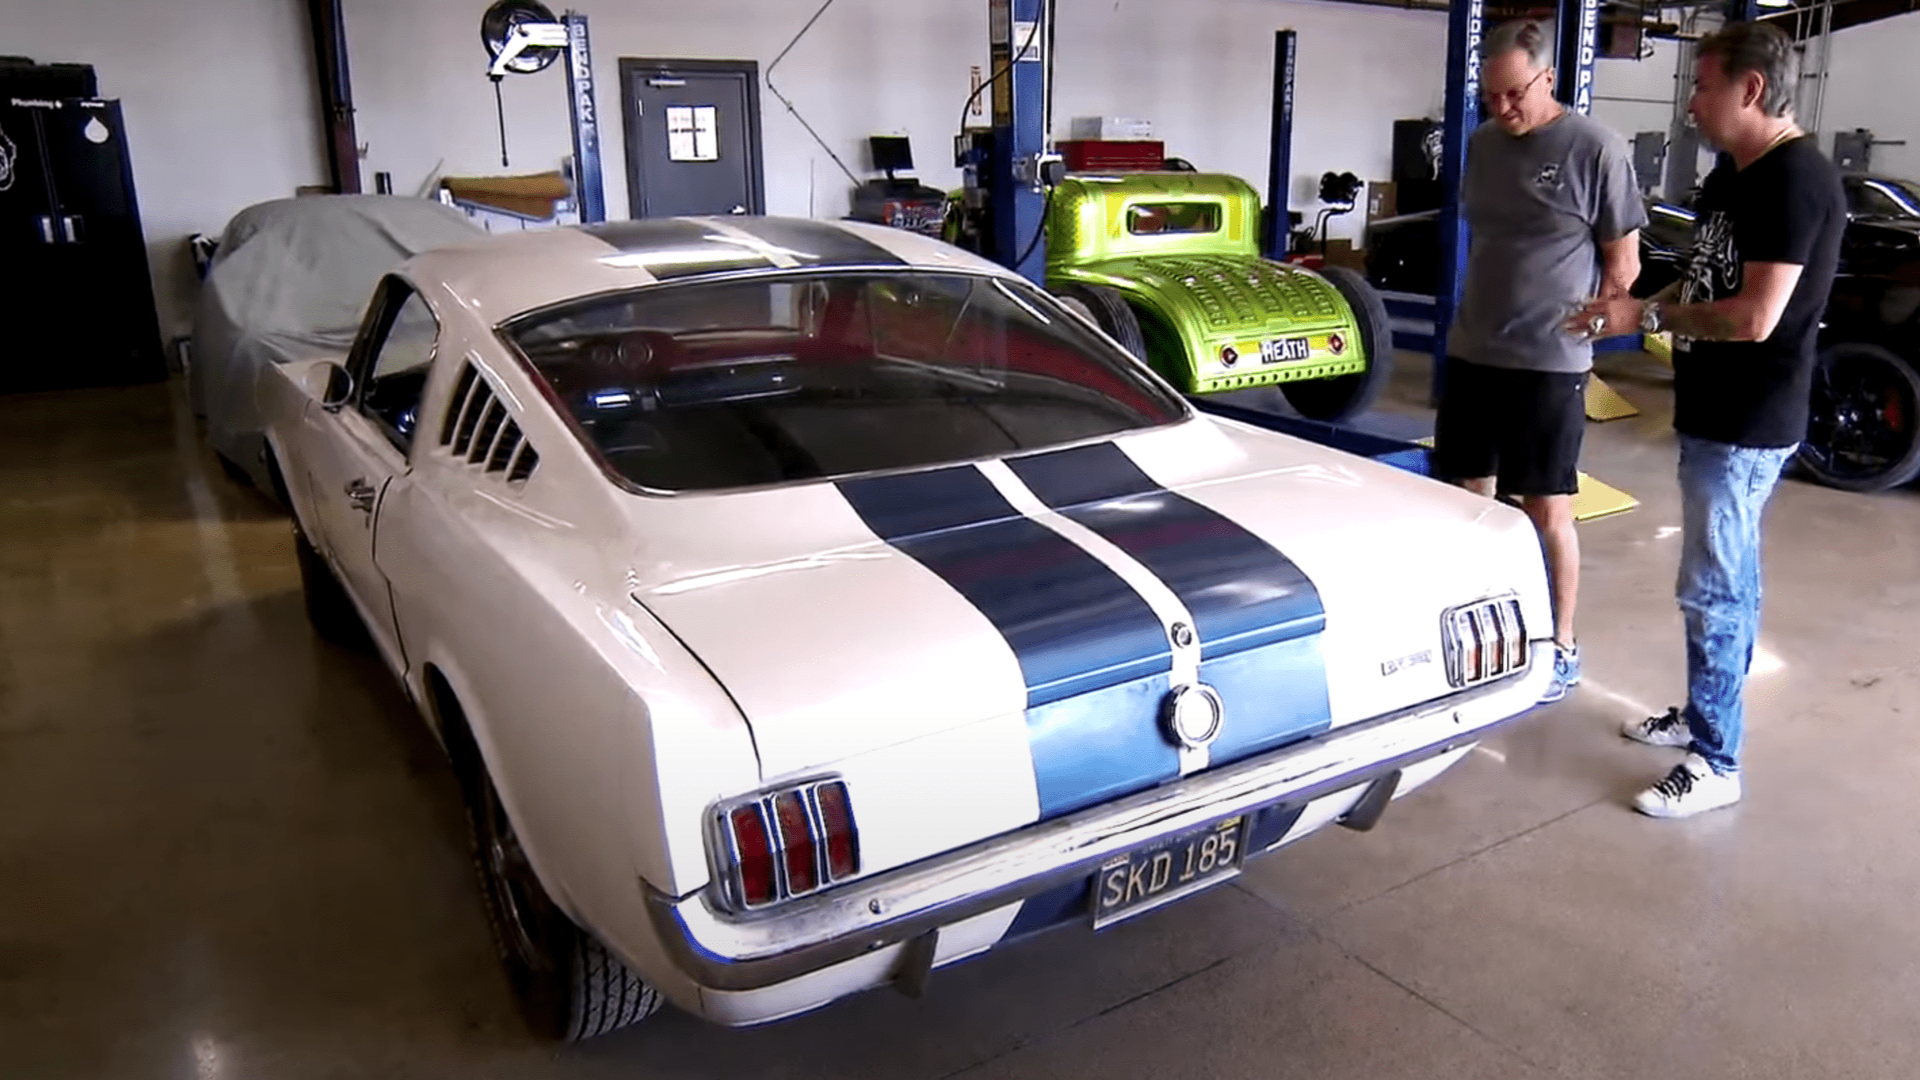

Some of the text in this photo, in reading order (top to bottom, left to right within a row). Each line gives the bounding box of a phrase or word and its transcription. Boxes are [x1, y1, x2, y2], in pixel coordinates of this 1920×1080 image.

[1468, 0, 1482, 80] NDPAK
[1262, 338, 1308, 363] HEATH
[1103, 852, 1171, 907] SKD
[1179, 827, 1236, 882] 185
